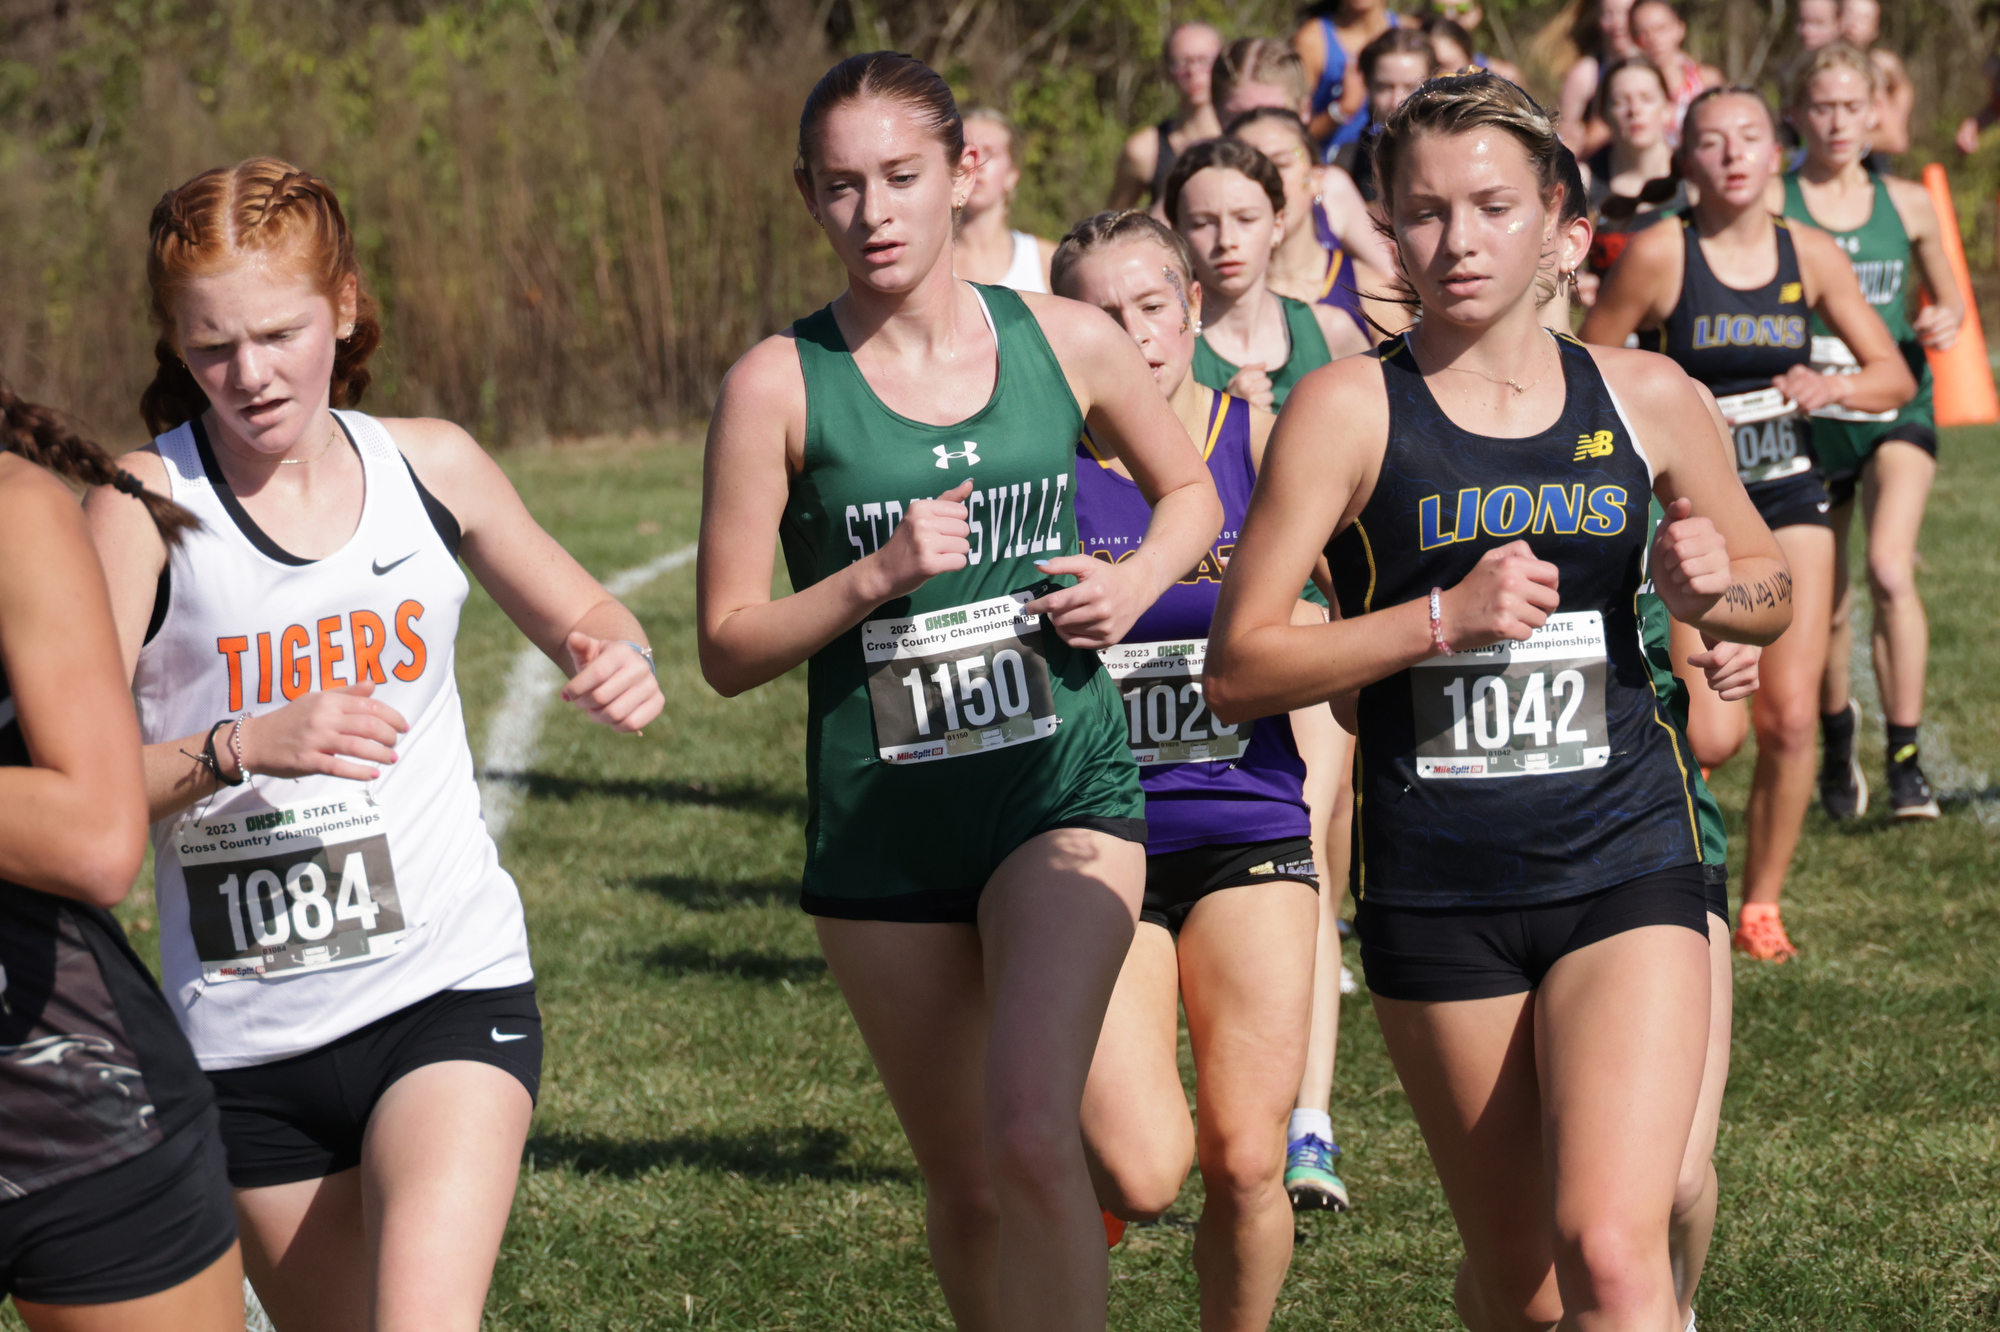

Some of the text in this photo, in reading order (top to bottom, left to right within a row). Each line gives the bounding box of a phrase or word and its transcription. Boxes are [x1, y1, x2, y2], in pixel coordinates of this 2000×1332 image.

[1692, 314, 1806, 349] LIONS
[1729, 417, 1797, 468] 046
[845, 473, 1068, 565] STSVILLE
[1419, 484, 1627, 551] LIONS
[1090, 536, 1129, 545] SAINT
[867, 614, 1036, 651] Cross Country Championships
[890, 603, 1010, 635] 2023 OHSAA STATE
[217, 598, 427, 712] TIGERS
[1124, 649, 1149, 657] 2023
[1157, 644, 1195, 657] OHSAA
[1456, 636, 1601, 653] untry Championships
[1102, 661, 1130, 669] ross
[1133, 659, 1174, 669] Country
[902, 649, 1030, 735] 1150
[1443, 669, 1587, 750] 1042
[947, 732, 968, 741] 01150
[1488, 749, 1511, 757] 01042
[897, 749, 931, 760] MileSplit
[1433, 765, 1469, 775] MileSplit
[180, 813, 380, 854] Cross Country Championships
[205, 802, 348, 836] 2023 OHSAA STATE
[219, 851, 379, 952] 1084
[262, 945, 287, 955] 01084
[220, 966, 255, 977] MileSplit
